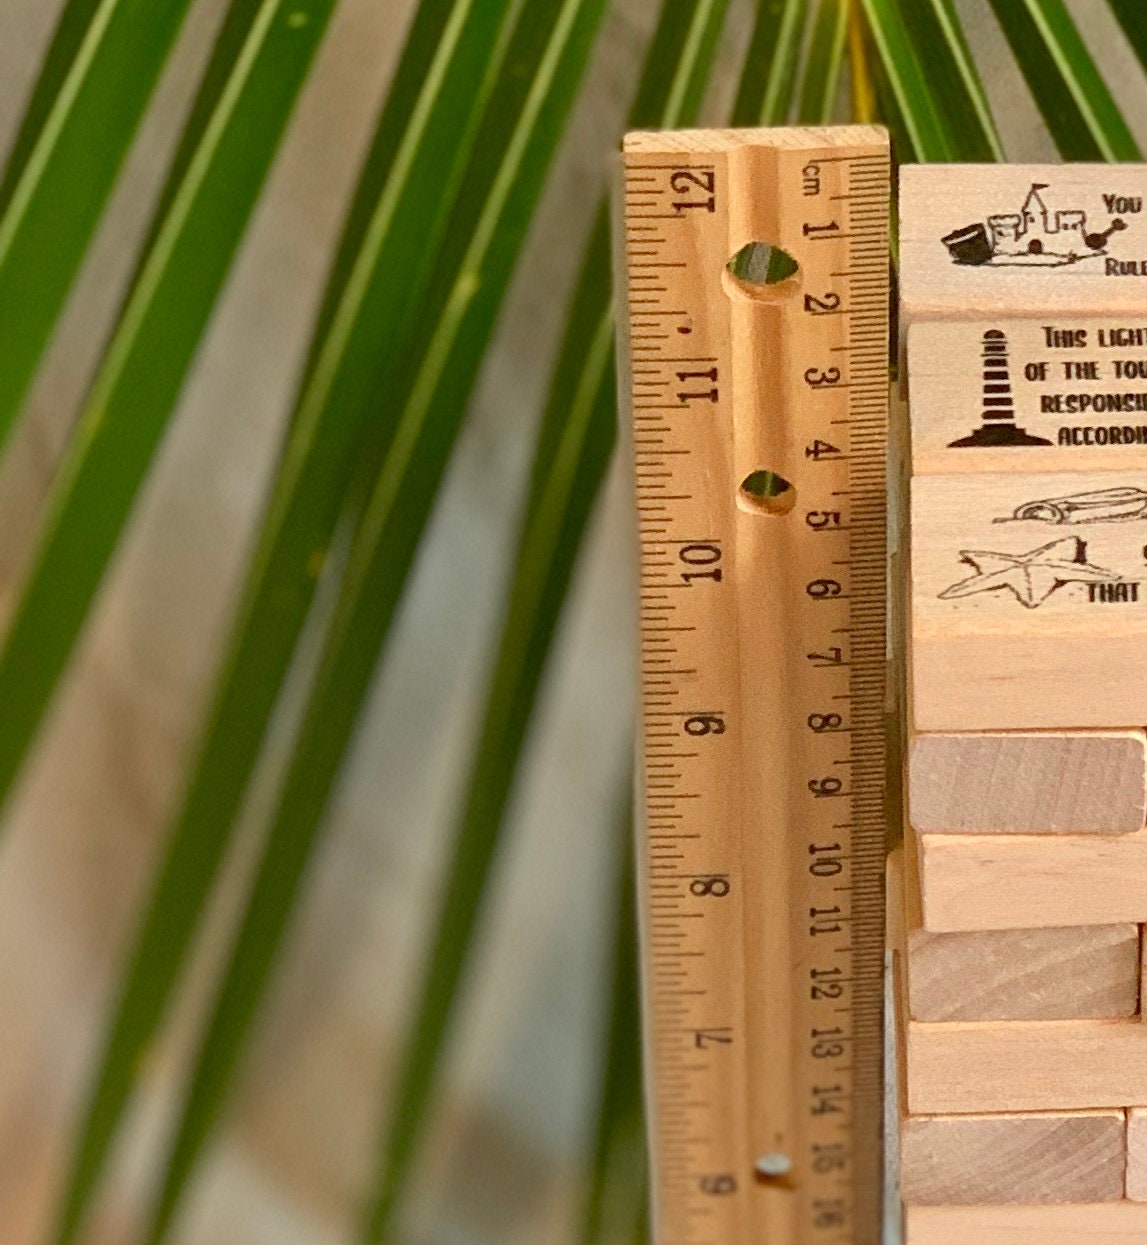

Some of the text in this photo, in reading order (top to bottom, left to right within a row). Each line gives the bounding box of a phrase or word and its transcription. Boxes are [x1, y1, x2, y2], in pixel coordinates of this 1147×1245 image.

[801, 163, 821, 197] cm
[669, 169, 715, 214] 12
[1102, 193, 1142, 214] YOU
[801, 221, 840, 236] 1
[803, 292, 841, 314] 2
[1041, 326, 1088, 349] THIS
[803, 366, 842, 387] 3
[1024, 361, 1049, 382] OF
[1062, 361, 1100, 380] THE
[674, 366, 720, 404] 11
[804, 439, 841, 459] 4
[804, 510, 841, 529] 5
[678, 543, 723, 583] 10
[805, 578, 842, 598] 6
[1087, 582, 1140, 603] THAT
[807, 712, 843, 733] 8
[808, 842, 843, 877] 10
[689, 877, 731, 898] 8
[809, 906, 842, 937] 11
[810, 967, 843, 1000] 12
[811, 1027, 844, 1059] 13
